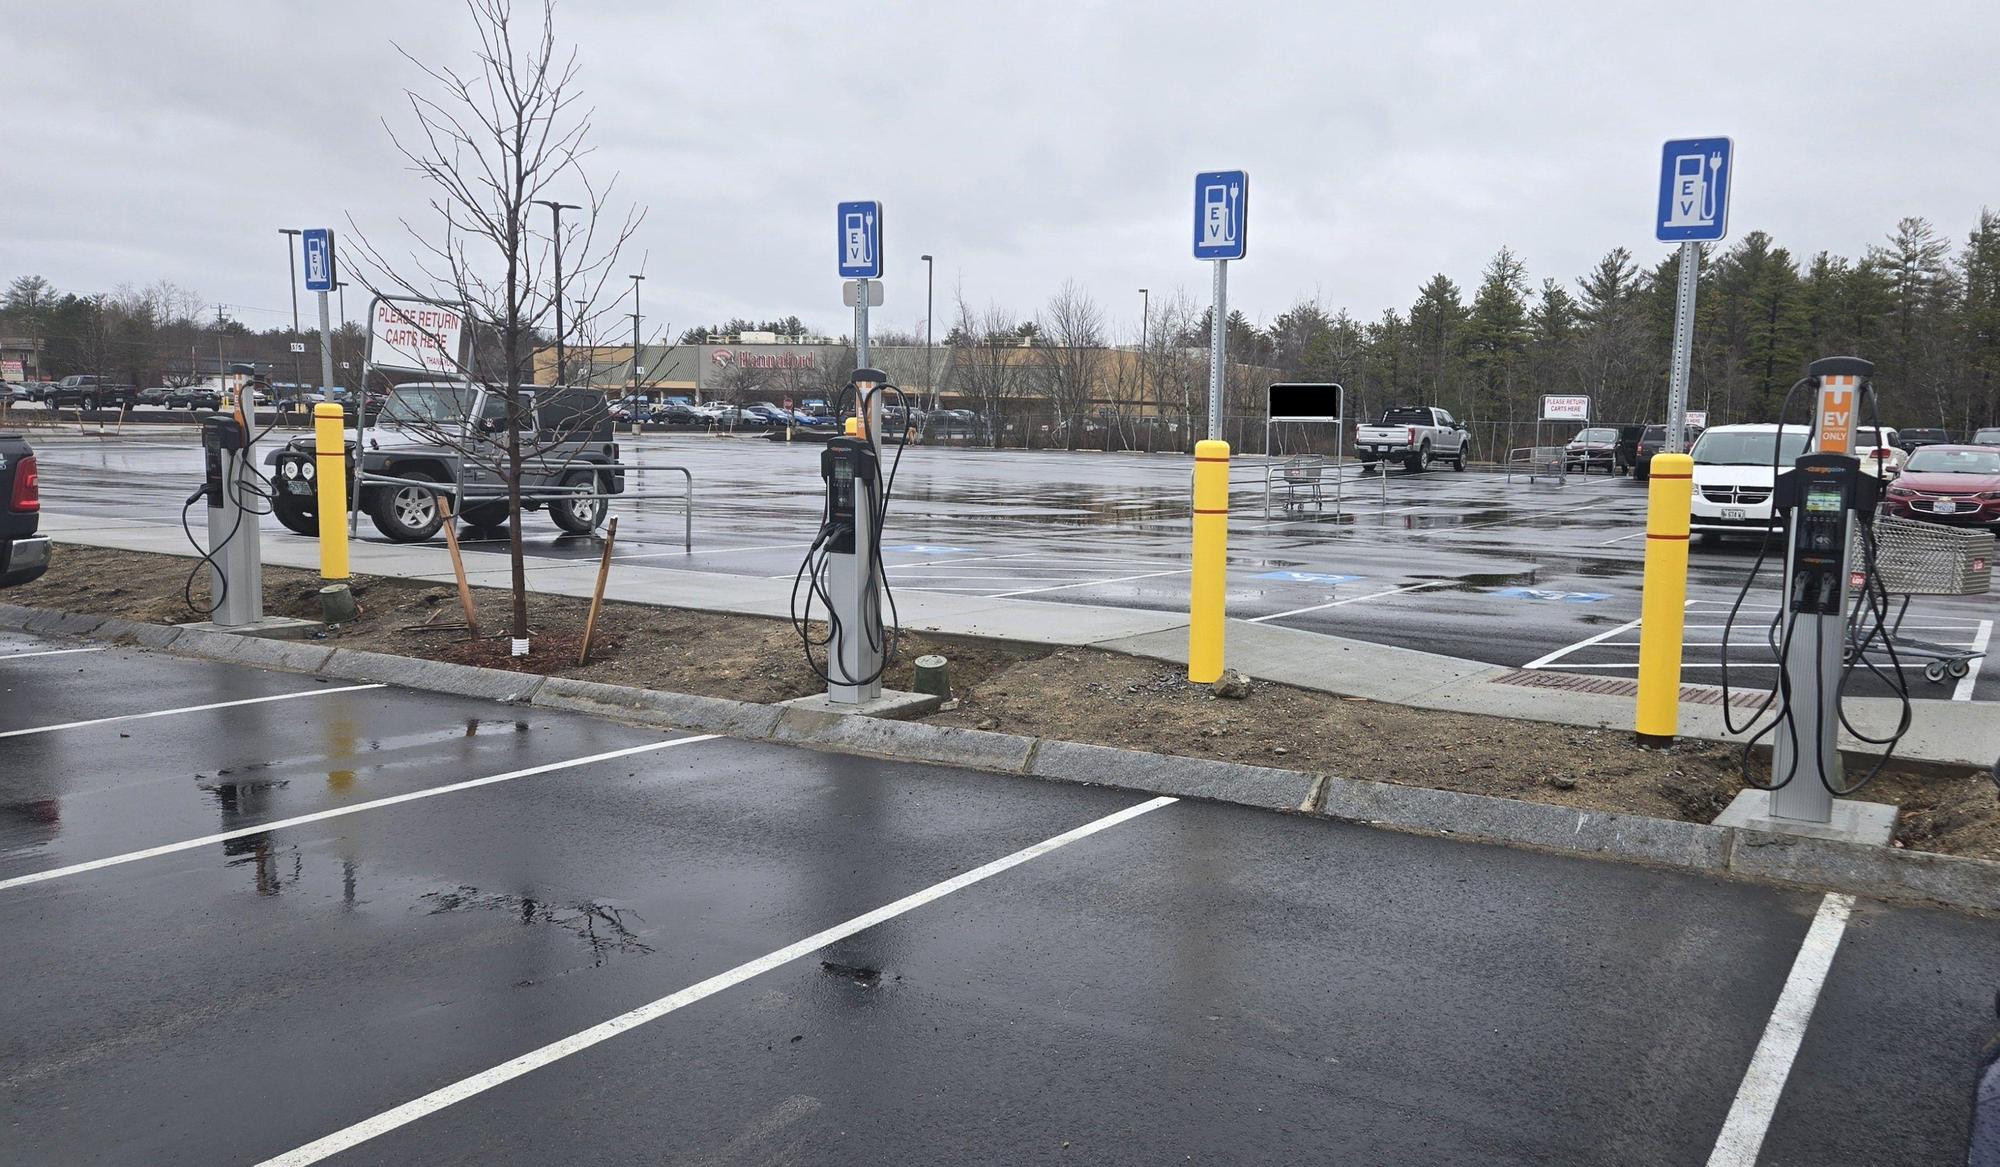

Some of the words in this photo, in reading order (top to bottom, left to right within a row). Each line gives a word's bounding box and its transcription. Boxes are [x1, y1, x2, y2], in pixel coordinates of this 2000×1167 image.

[1680, 180, 1694, 216] EV
[1210, 207, 1220, 238] EV
[850, 232, 859, 260] EV
[312, 254, 319, 276] EV
[378, 307, 416, 324] PLEASE
[418, 311, 459, 330] RETURN
[385, 329, 418, 347] CARTS
[419, 331, 447, 350] HERE
[1823, 411, 1849, 426] EV
[1822, 432, 1848, 441] ONLY
